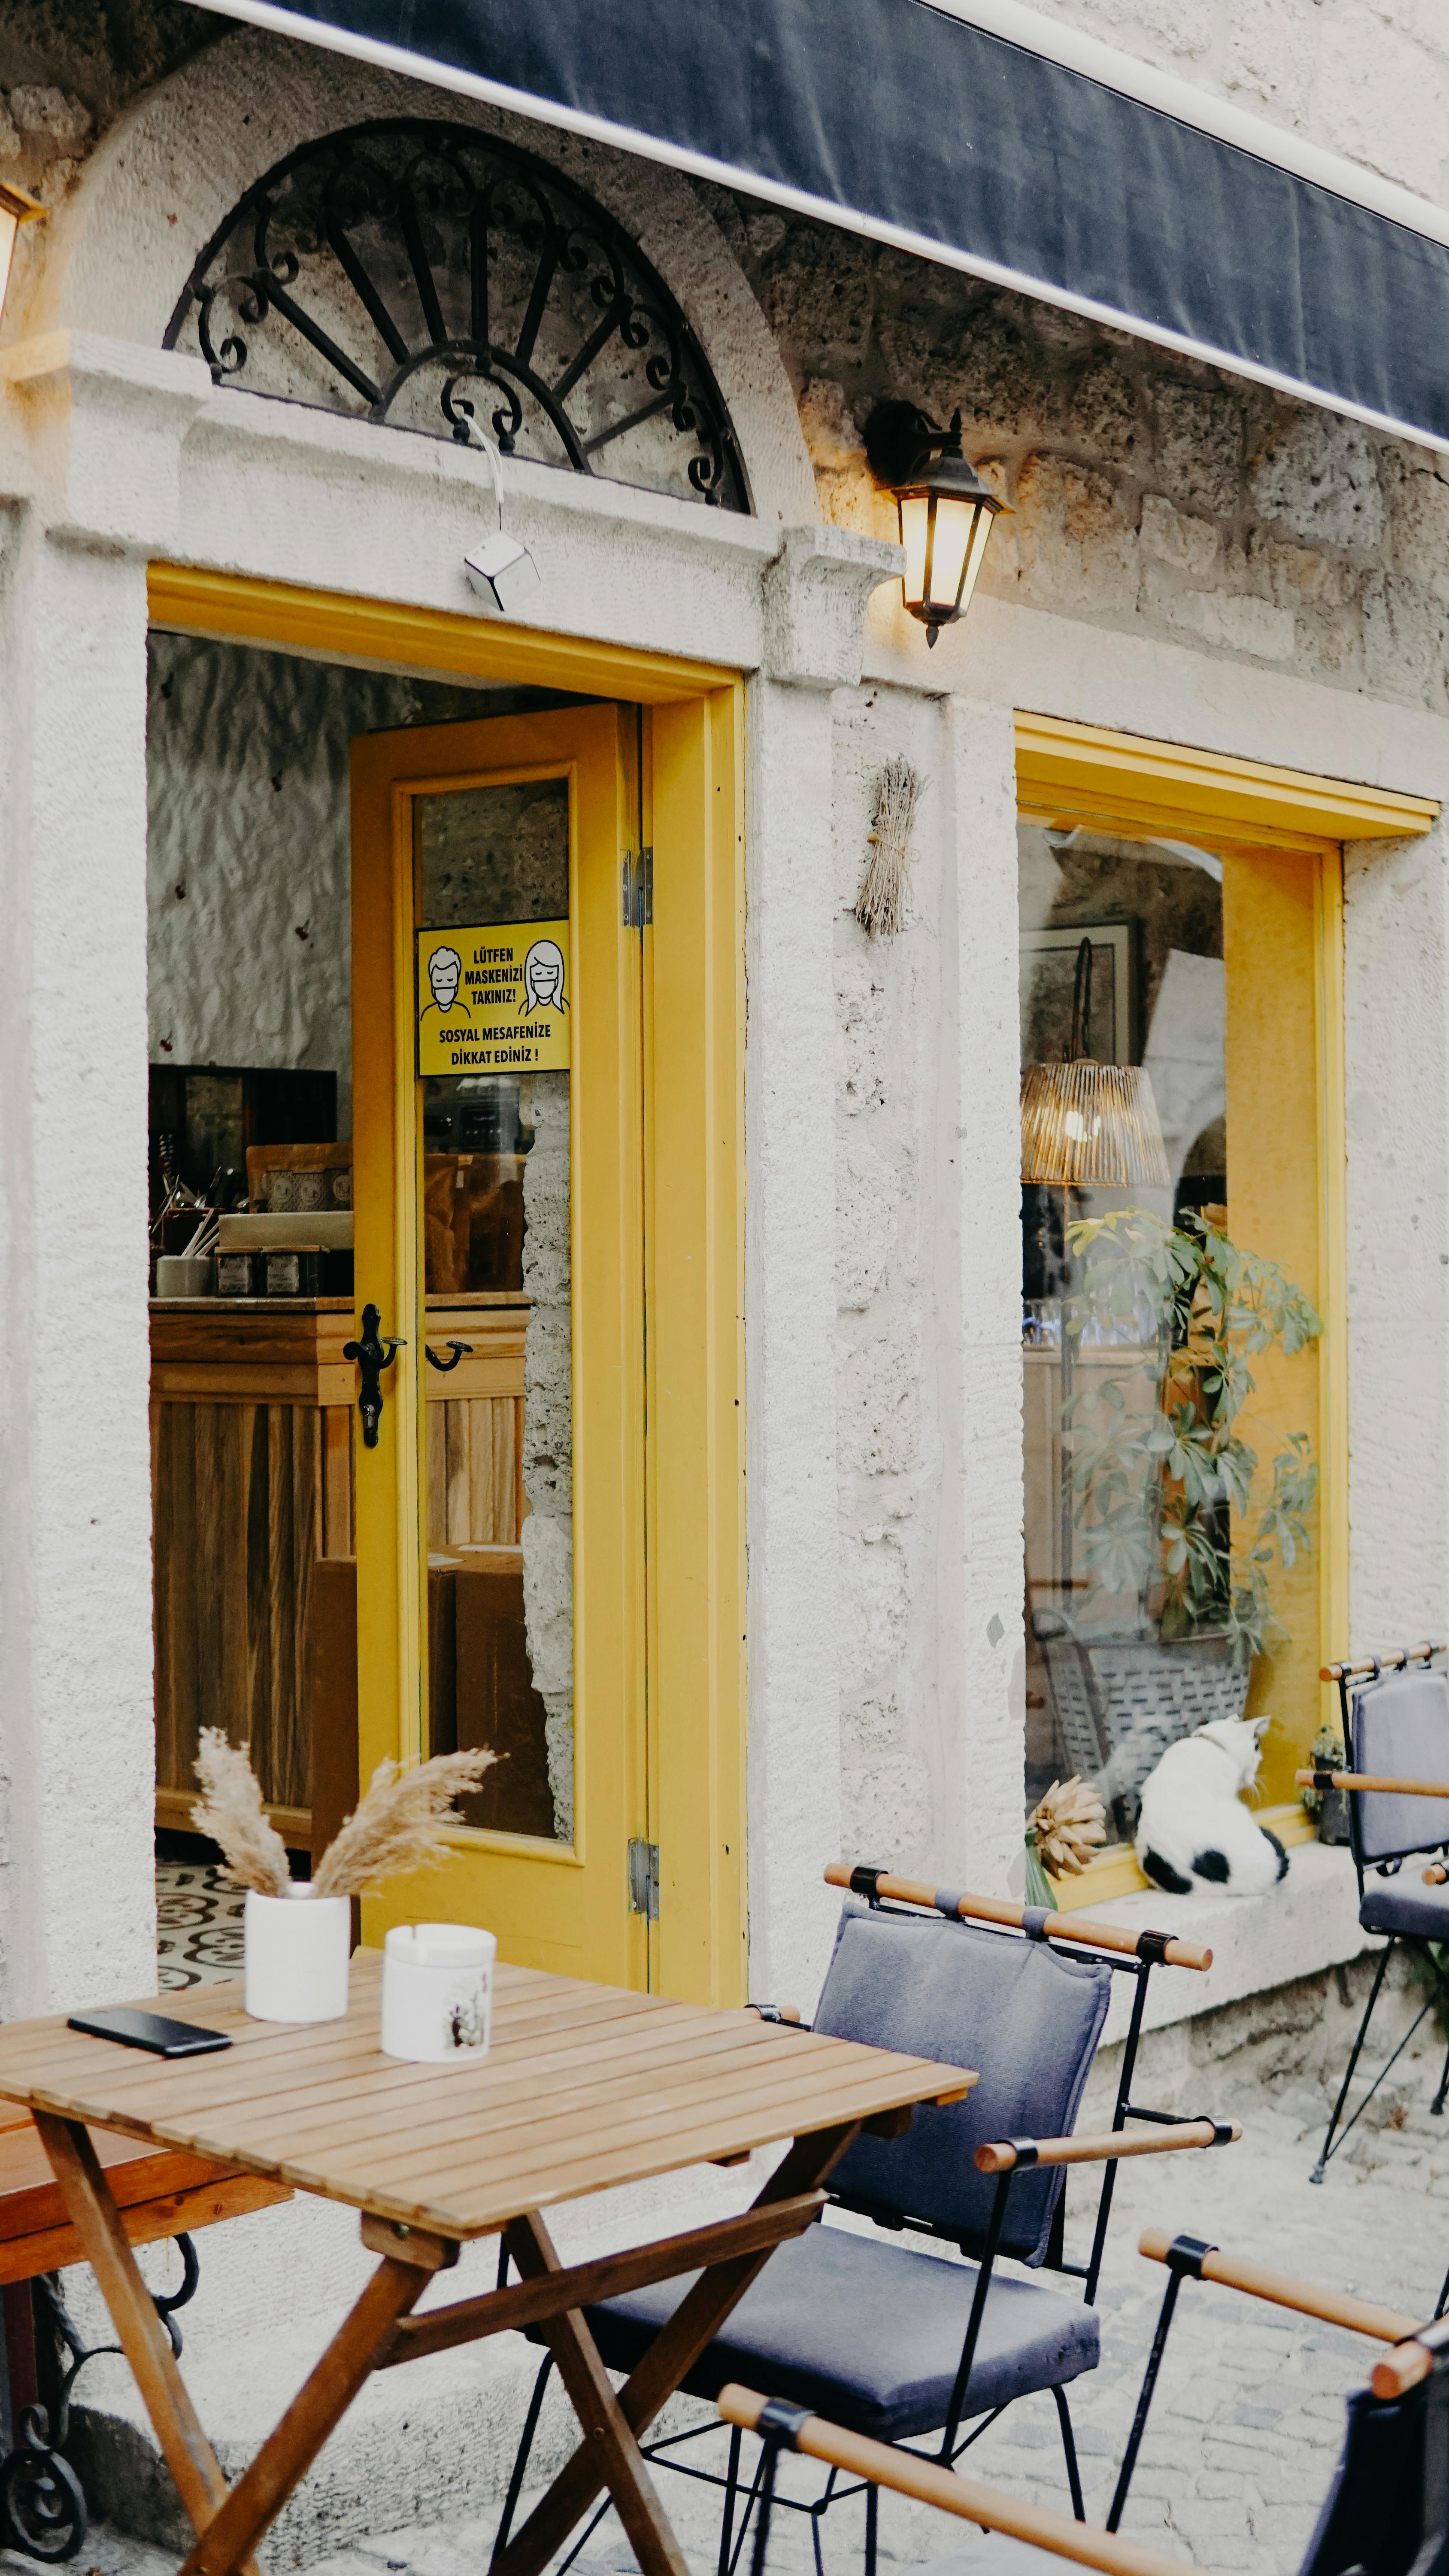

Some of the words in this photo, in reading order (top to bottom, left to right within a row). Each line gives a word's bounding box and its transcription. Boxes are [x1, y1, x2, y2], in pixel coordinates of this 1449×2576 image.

[474, 946, 513, 964] LÜTFEN
[465, 964, 523, 985] MASKENİZİ
[471, 989, 516, 1005] TAKINIZ!
[439, 1029, 480, 1043] SOSYAL
[482, 1021, 551, 1041] MESAFENİZE
[452, 1048, 492, 1065] DİKKAT
[494, 1045, 531, 1063] EDİNİZ
